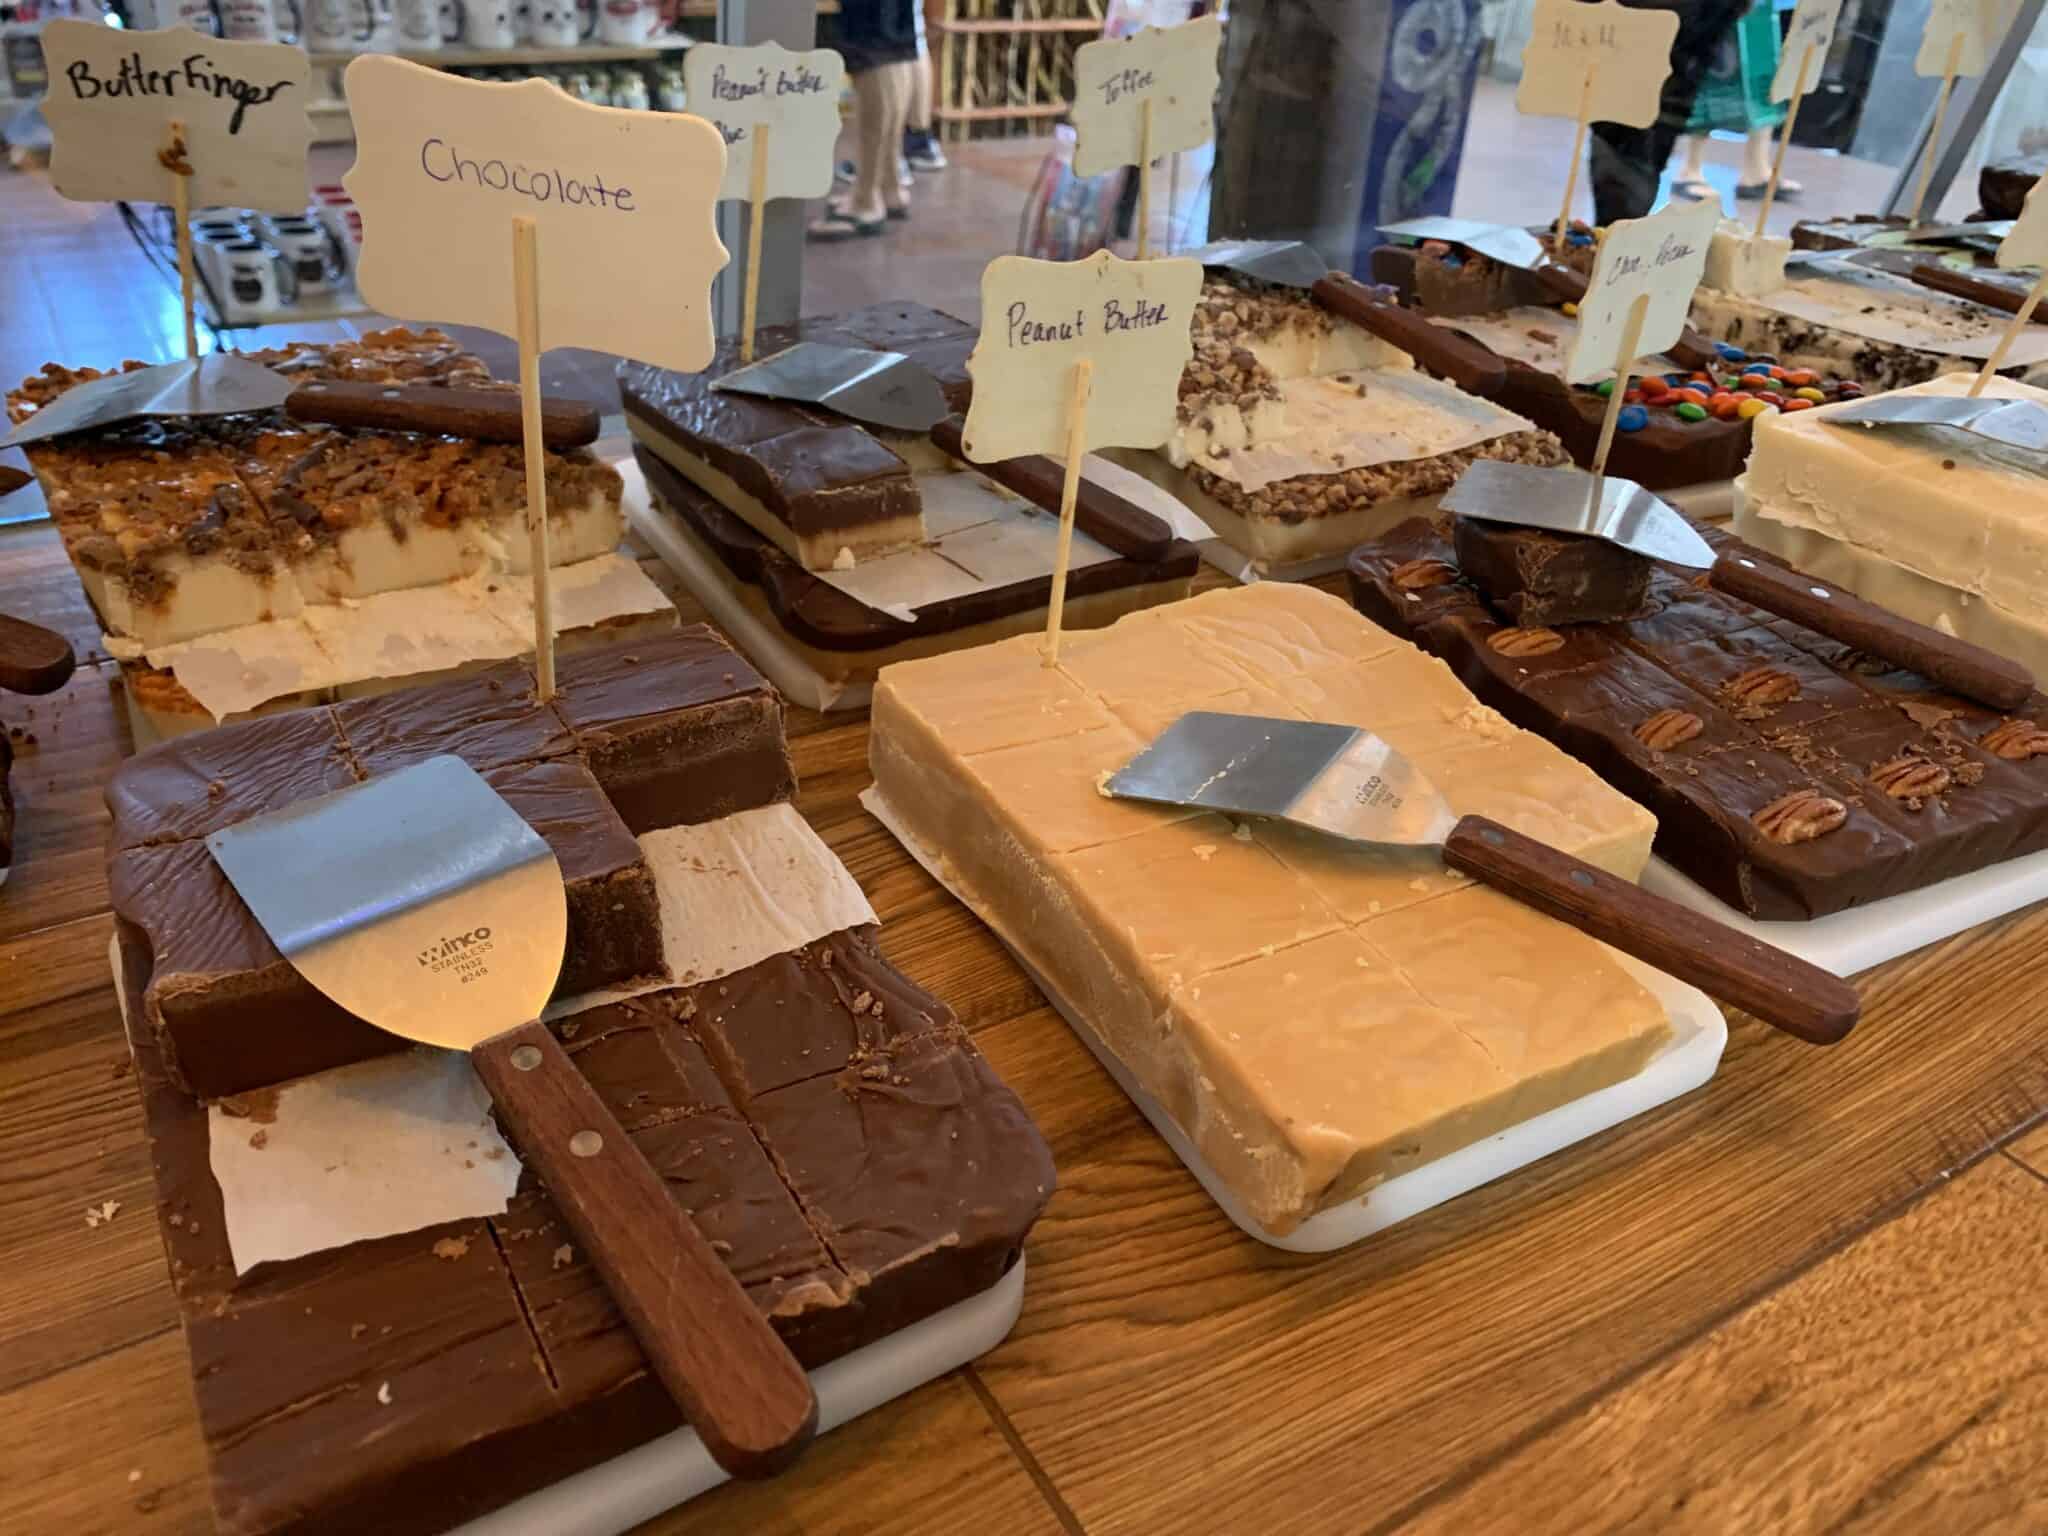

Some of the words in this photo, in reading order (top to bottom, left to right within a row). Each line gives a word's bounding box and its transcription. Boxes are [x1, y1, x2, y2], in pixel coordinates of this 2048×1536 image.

[421, 138, 636, 211] Chocolate
[1006, 302, 1083, 348] Peanut
[1103, 299, 1168, 335] Butter
[416, 927, 491, 968] Winco
